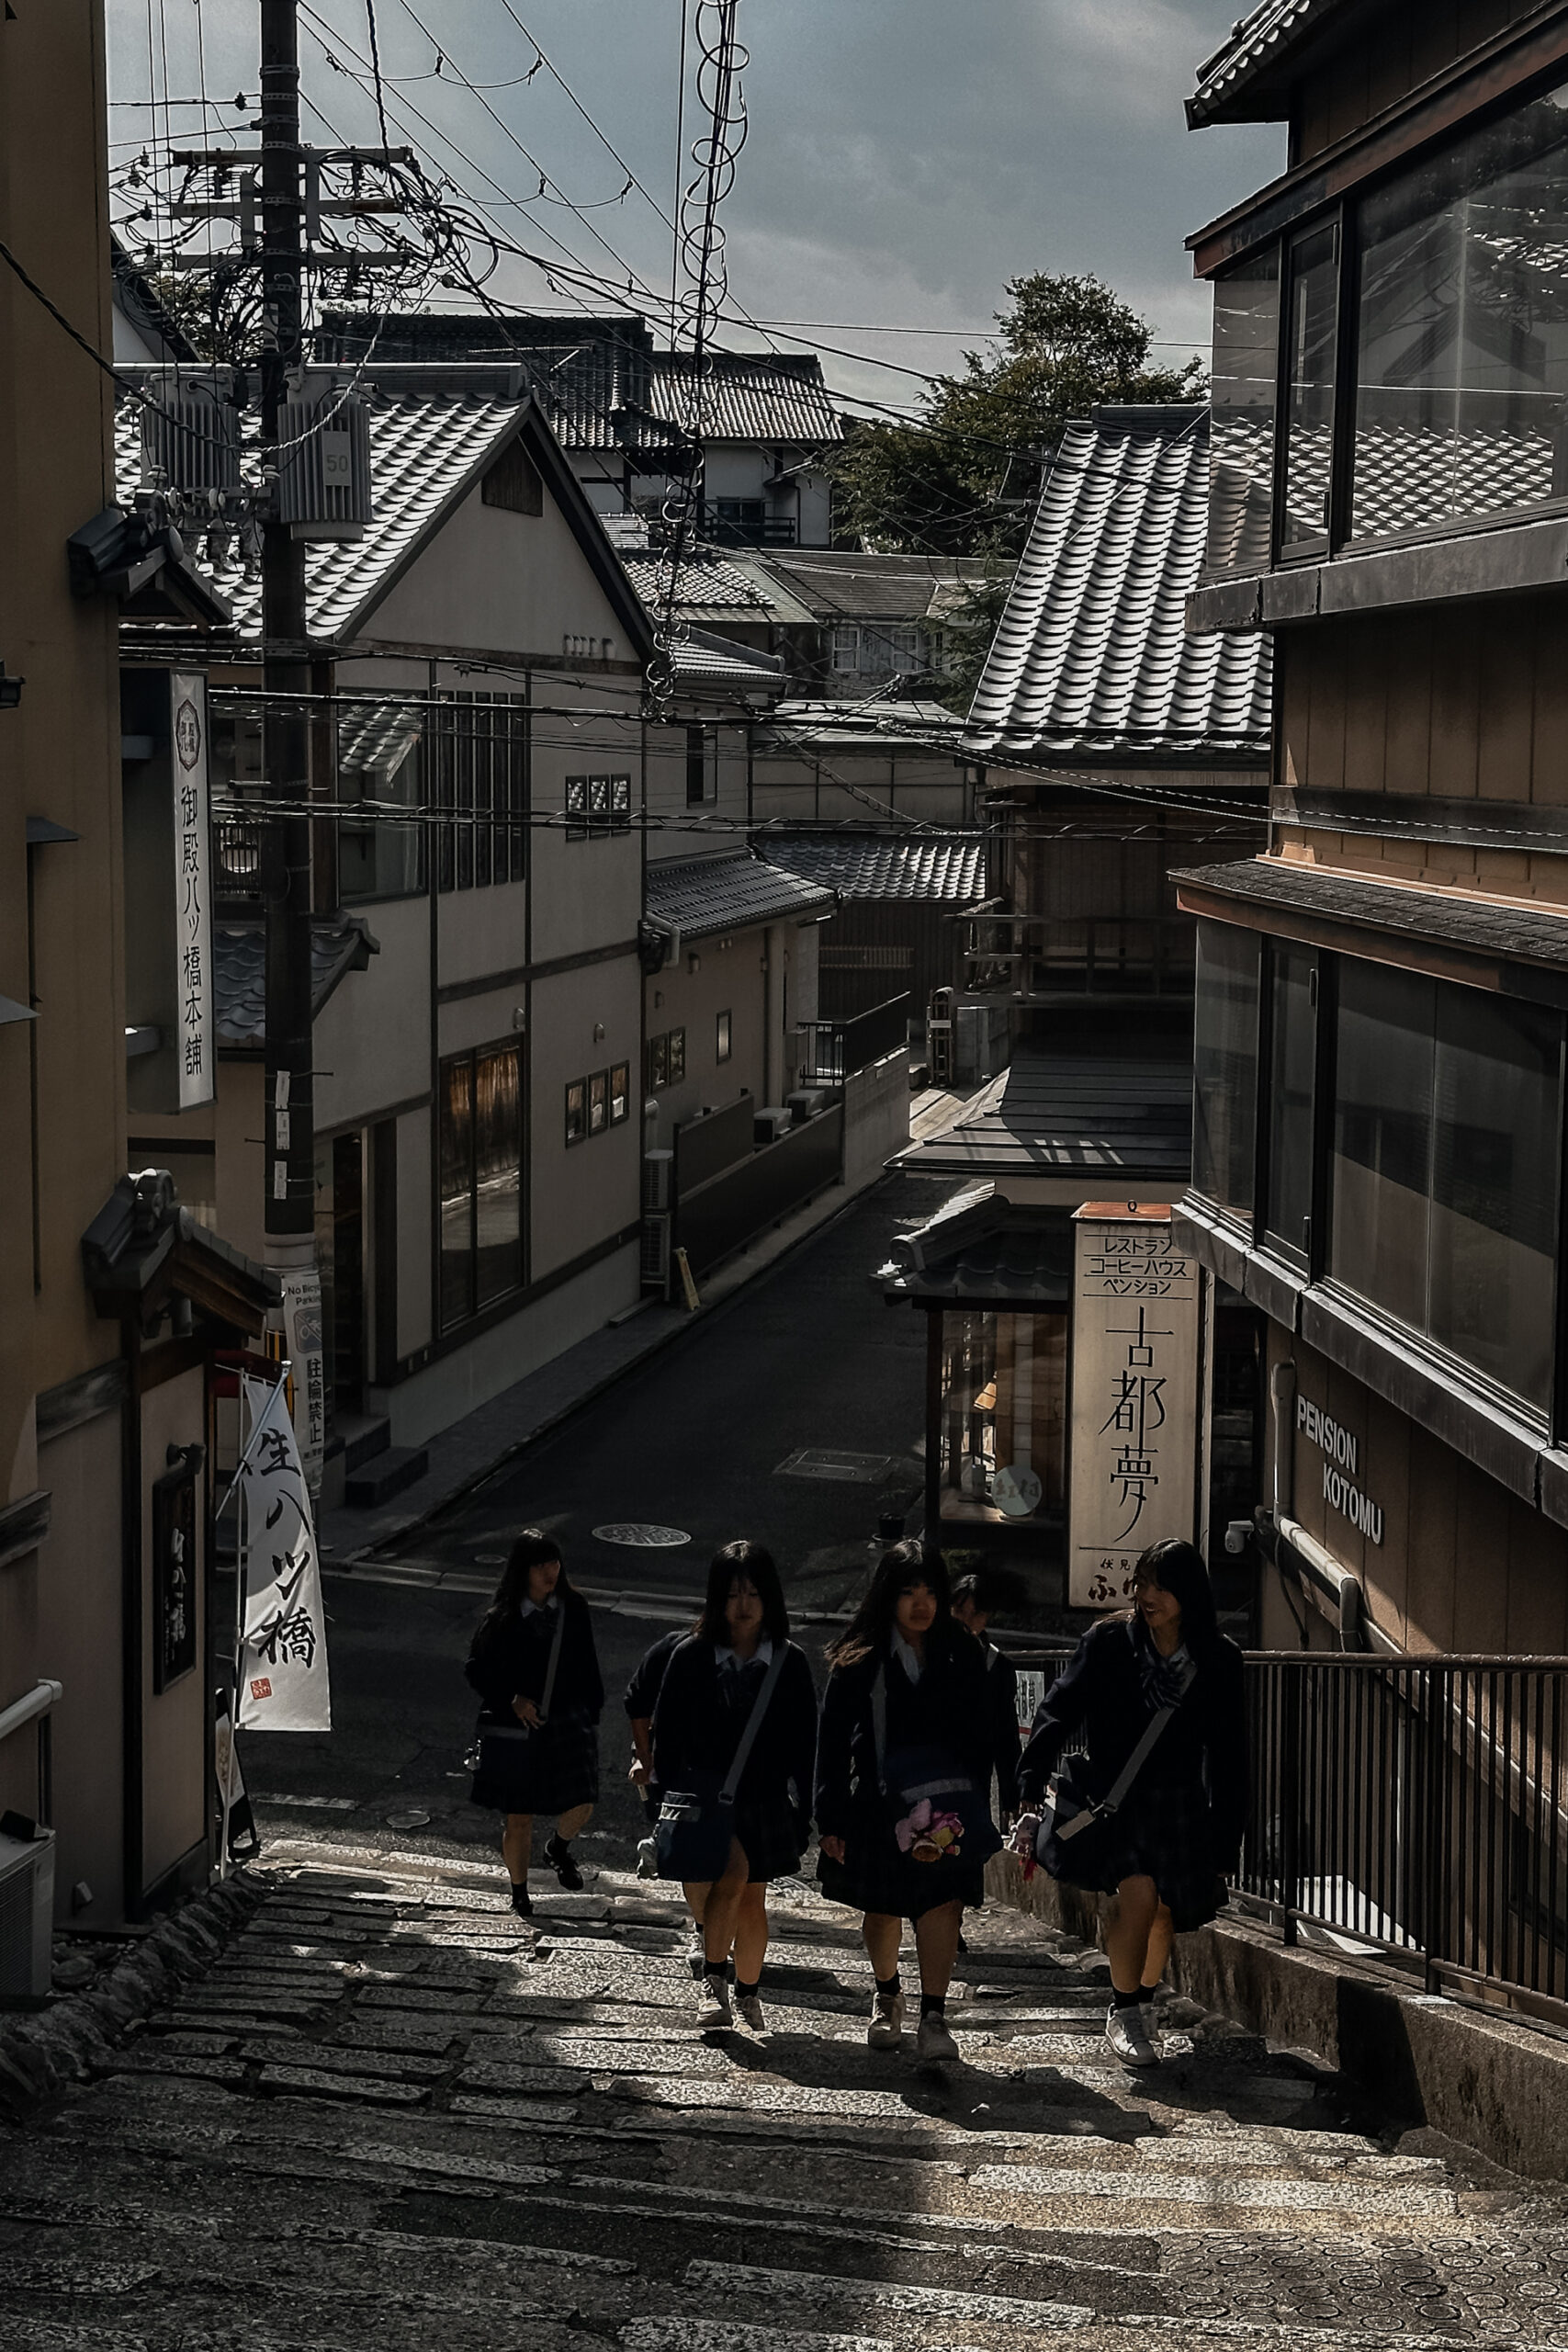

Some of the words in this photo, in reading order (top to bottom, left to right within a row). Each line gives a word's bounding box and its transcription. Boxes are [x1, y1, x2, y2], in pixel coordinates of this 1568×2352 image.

[326, 455, 348, 472] 50
[180, 785, 203, 1076] 御殿八ツ橋本舗
[1089, 1257, 1187, 1277] コーヒーハウス
[1104, 1236, 1173, 1256] レストラン
[287, 1286, 301, 1295] No
[1102, 1278, 1172, 1296] ペンション
[307, 1358, 321, 1444] 駐輪禁止
[1099, 1306, 1175, 1543] 古都夢
[1297, 1395, 1358, 1475] PENSION
[1323, 1462, 1382, 1544] KOTOMU
